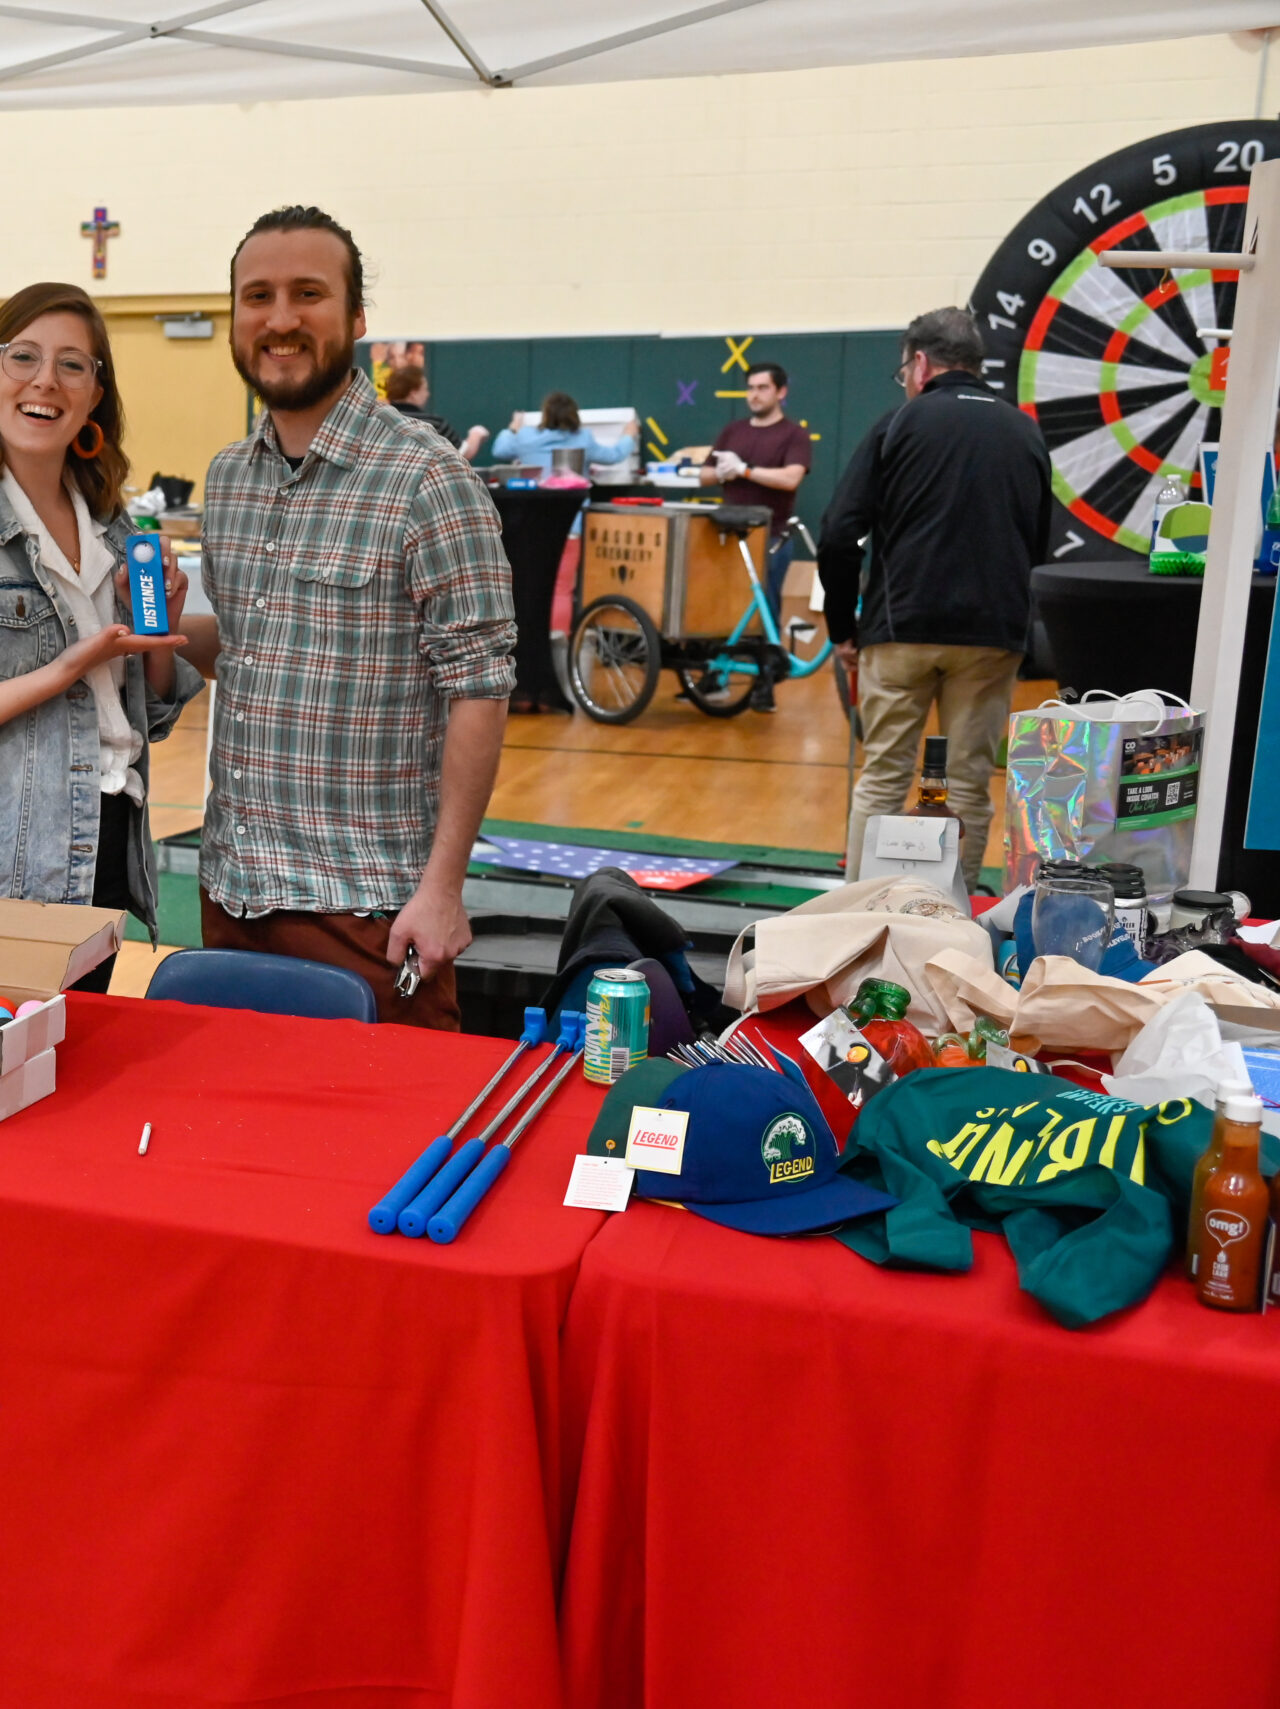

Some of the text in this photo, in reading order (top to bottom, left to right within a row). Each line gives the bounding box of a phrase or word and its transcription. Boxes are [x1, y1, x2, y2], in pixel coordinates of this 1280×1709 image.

[1152, 154, 1177, 186] 5
[1214, 140, 1264, 173] 20
[1073, 183, 1121, 225] 12
[1027, 238, 1057, 267] 9
[988, 290, 1025, 331] 14
[1053, 531, 1085, 558] 7
[632, 1129, 679, 1146] LEGEND
[770, 1156, 813, 1183] LEGEND
[1209, 1218, 1244, 1237] omg!
